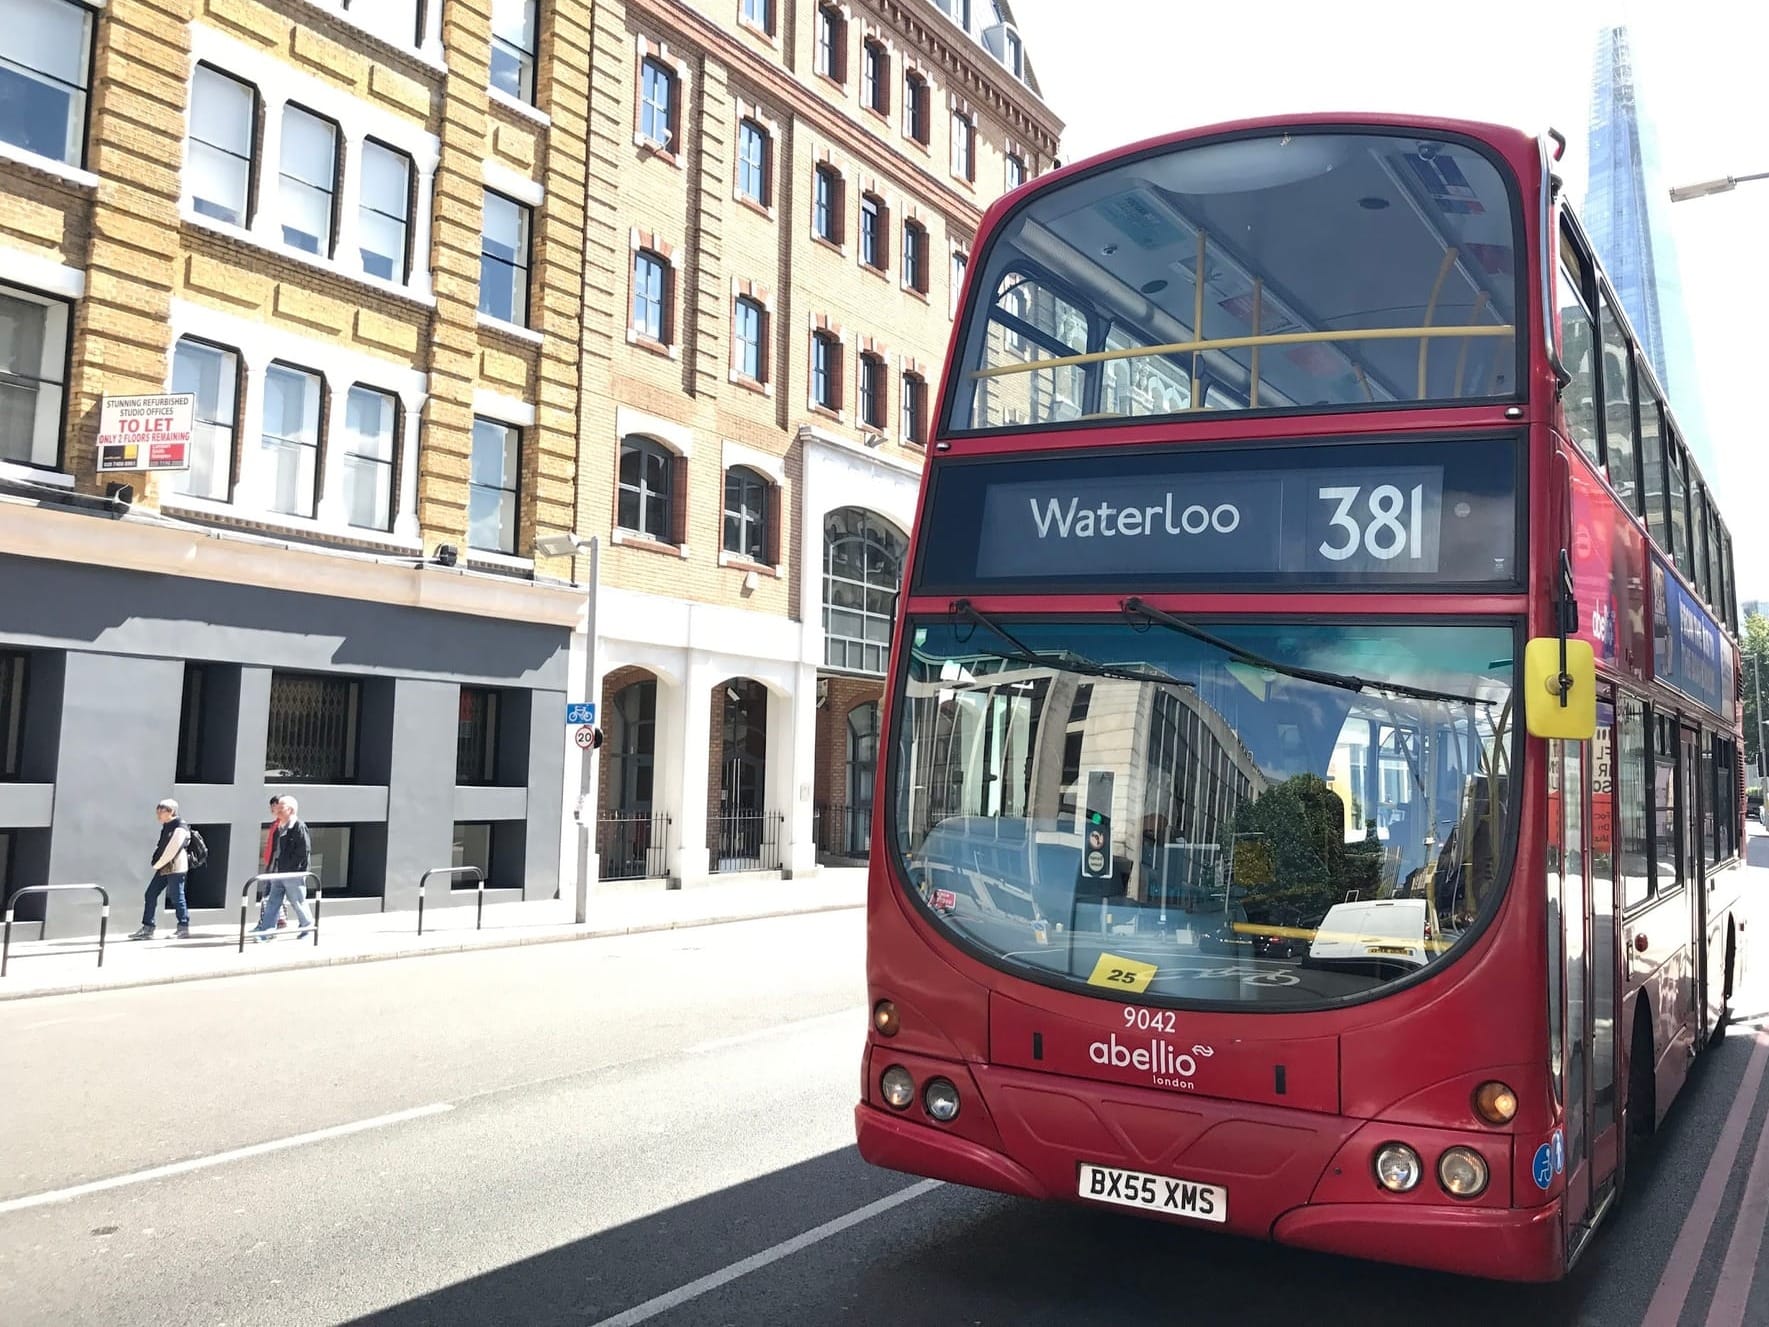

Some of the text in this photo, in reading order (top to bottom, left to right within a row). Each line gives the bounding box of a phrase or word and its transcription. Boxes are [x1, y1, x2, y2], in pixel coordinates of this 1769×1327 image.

[106, 397, 189, 408] STUNNING REFURBISHED
[120, 407, 173, 417] STUDIO OFFICES
[119, 418, 173, 433] TO LET
[98, 434, 117, 444] ONLY
[124, 433, 150, 443] FLOORS
[151, 432, 190, 442] REMAINING
[1030, 484, 1422, 561] Waterloo 381
[578, 732, 592, 743] 20
[1107, 969, 1137, 984] 25
[1123, 1006, 1176, 1033] 9042
[1089, 1033, 1197, 1077] abellio
[1152, 1075, 1195, 1090] london
[1090, 1168, 1214, 1214] BX55 XMS
